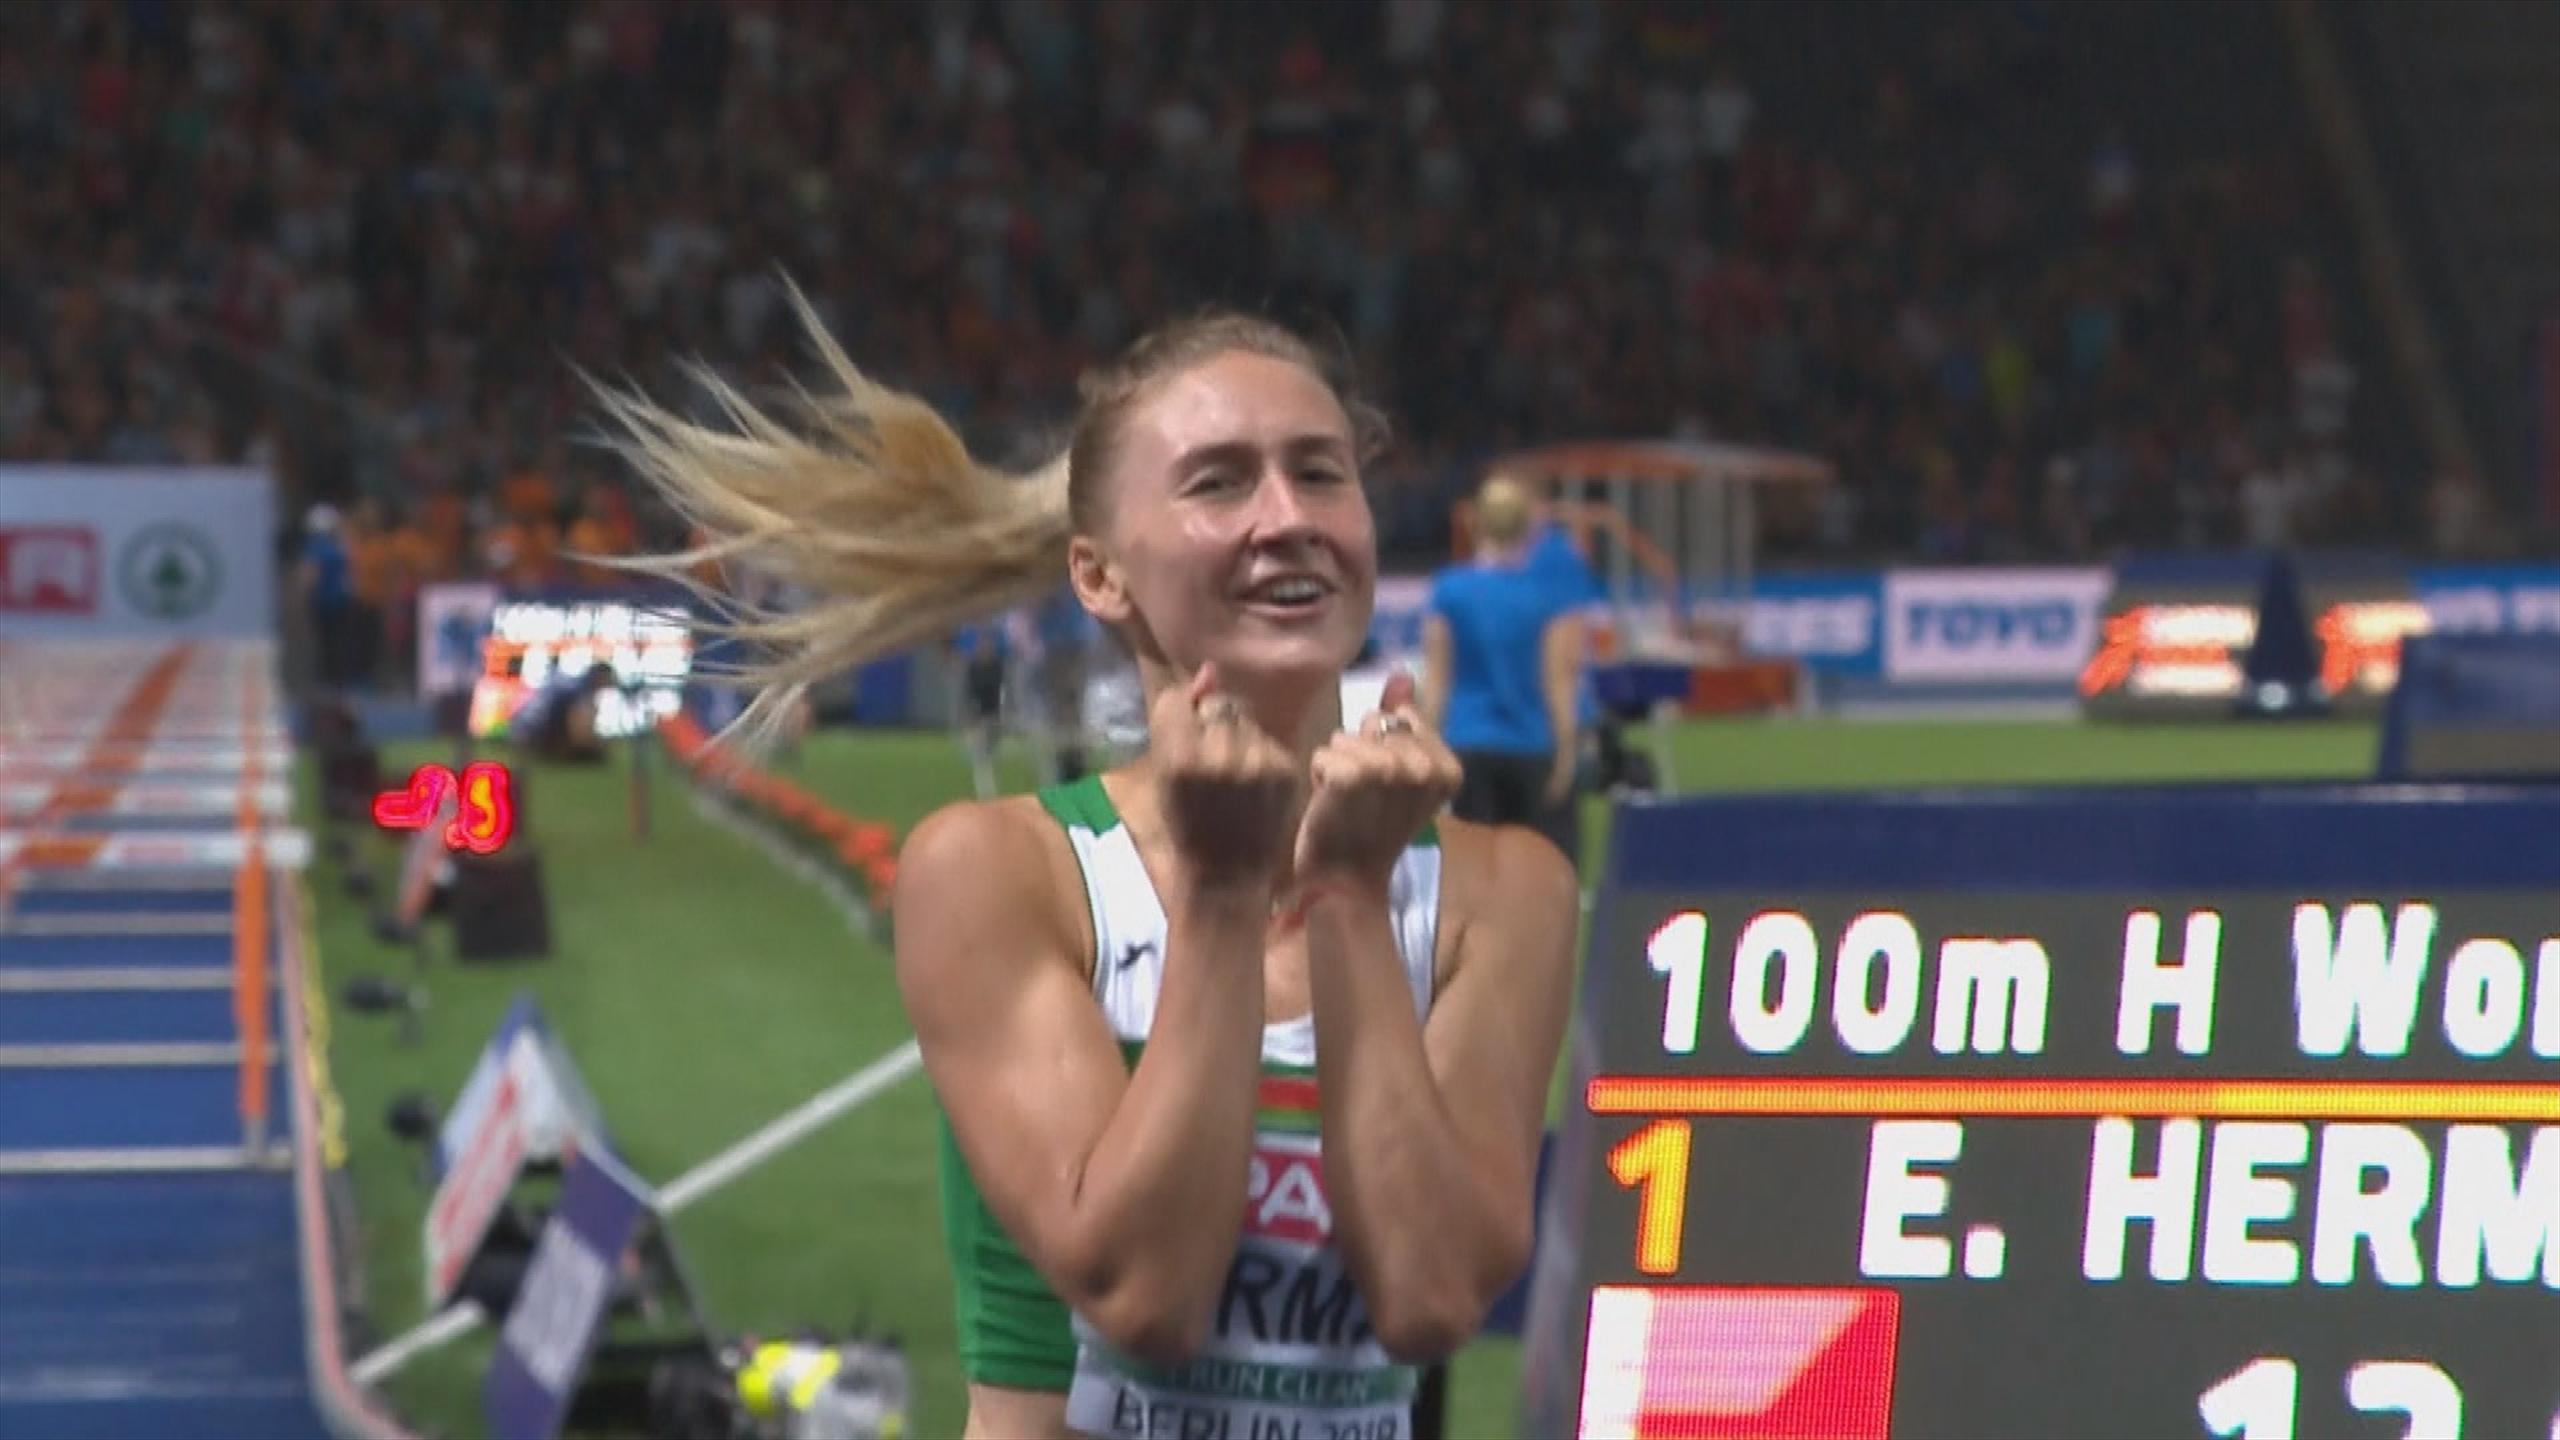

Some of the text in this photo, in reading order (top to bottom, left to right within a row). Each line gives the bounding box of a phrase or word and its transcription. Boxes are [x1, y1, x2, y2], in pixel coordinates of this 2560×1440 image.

[1646, 902, 2560, 1058] 100m H Wo
[1607, 1120, 1691, 1276] 1
[1860, 1119, 2006, 1279] E.
[1215, 1252, 1374, 1346] RM
